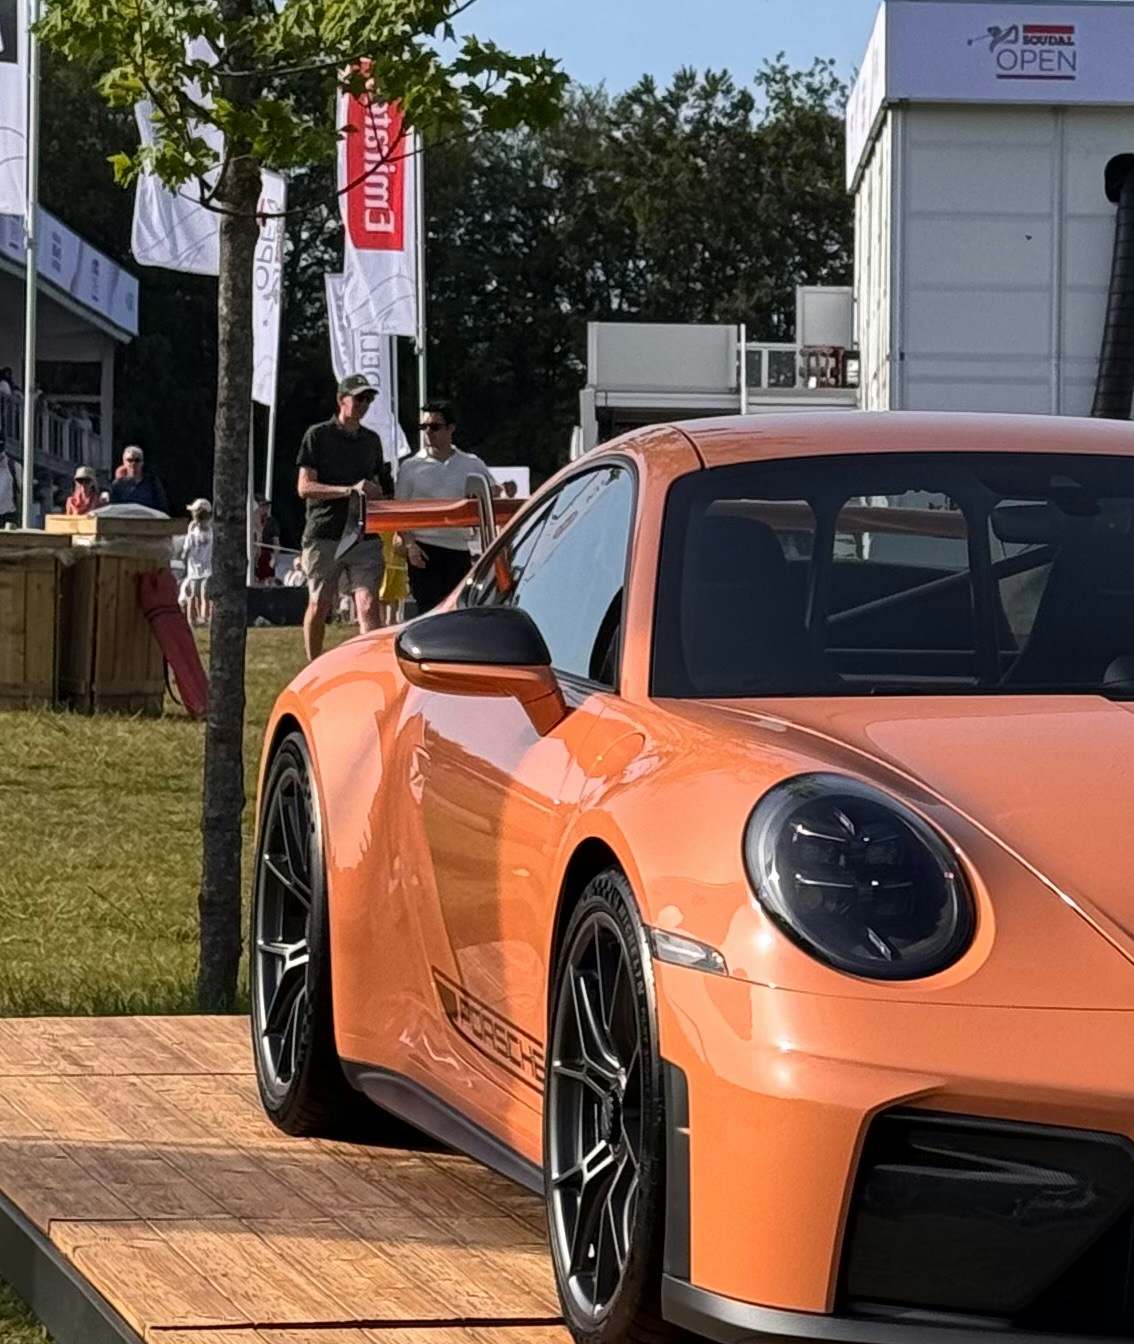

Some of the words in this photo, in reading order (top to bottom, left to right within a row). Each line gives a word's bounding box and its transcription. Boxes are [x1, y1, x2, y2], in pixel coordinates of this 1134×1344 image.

[1022, 35, 1076, 46] SOUDAL
[996, 48, 1077, 71] OPEN
[458, 995, 545, 1085] PORSCHE
